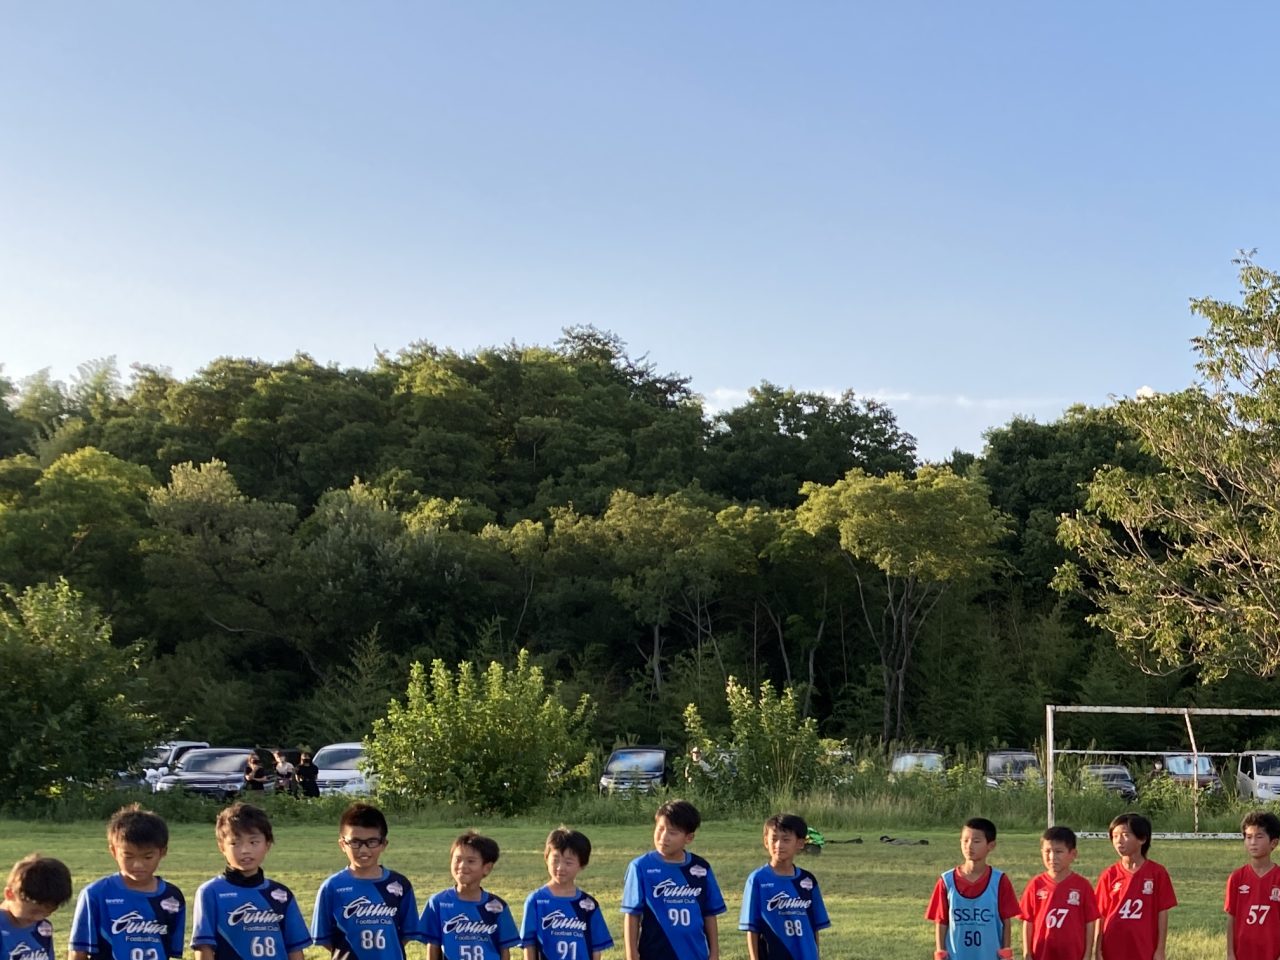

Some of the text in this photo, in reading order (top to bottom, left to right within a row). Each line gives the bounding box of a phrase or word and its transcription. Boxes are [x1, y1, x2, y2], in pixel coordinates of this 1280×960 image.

[343, 896, 397, 920] Outline
[668, 908, 691, 926] 90
[1118, 899, 1145, 920] 42
[1246, 905, 1271, 925] 57
[784, 919, 803, 936] 88
[1045, 908, 1069, 929] 67
[251, 937, 276, 957] 68
[361, 929, 386, 949] 86
[964, 931, 982, 947] 50
[557, 941, 577, 960] 91
